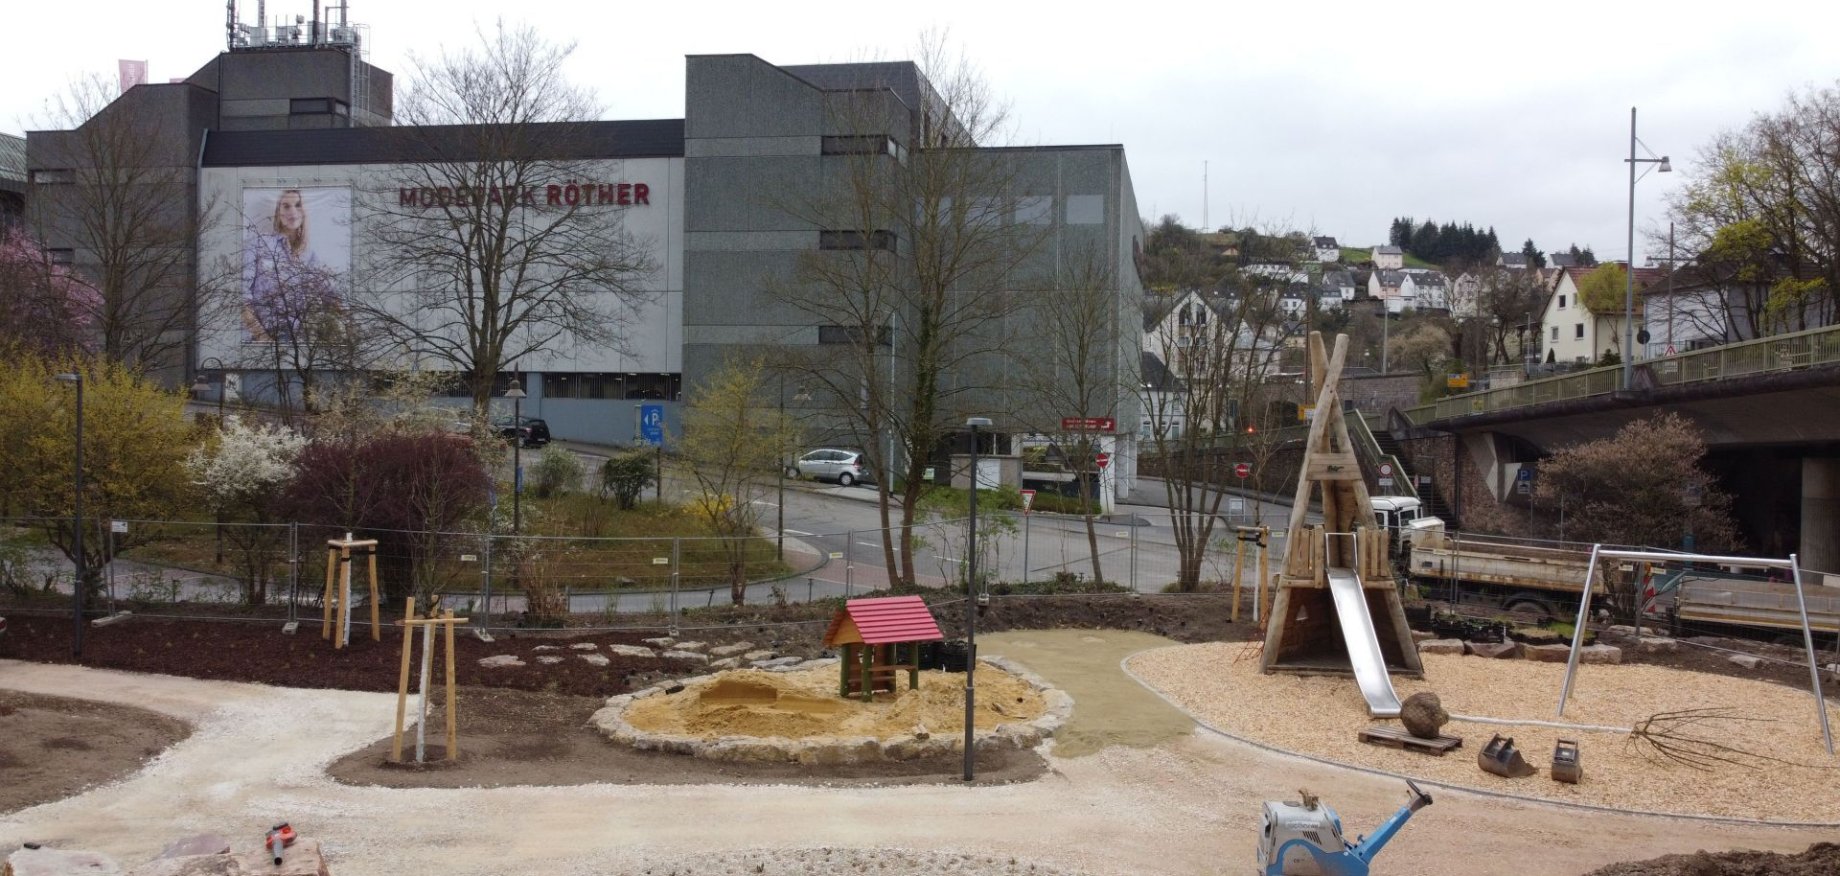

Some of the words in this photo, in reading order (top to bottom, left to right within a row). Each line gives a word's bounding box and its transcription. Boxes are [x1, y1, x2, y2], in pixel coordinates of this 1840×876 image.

[546, 179, 650, 206] RÖTHER
[652, 412, 660, 426] P
[1520, 470, 1529, 480] P
